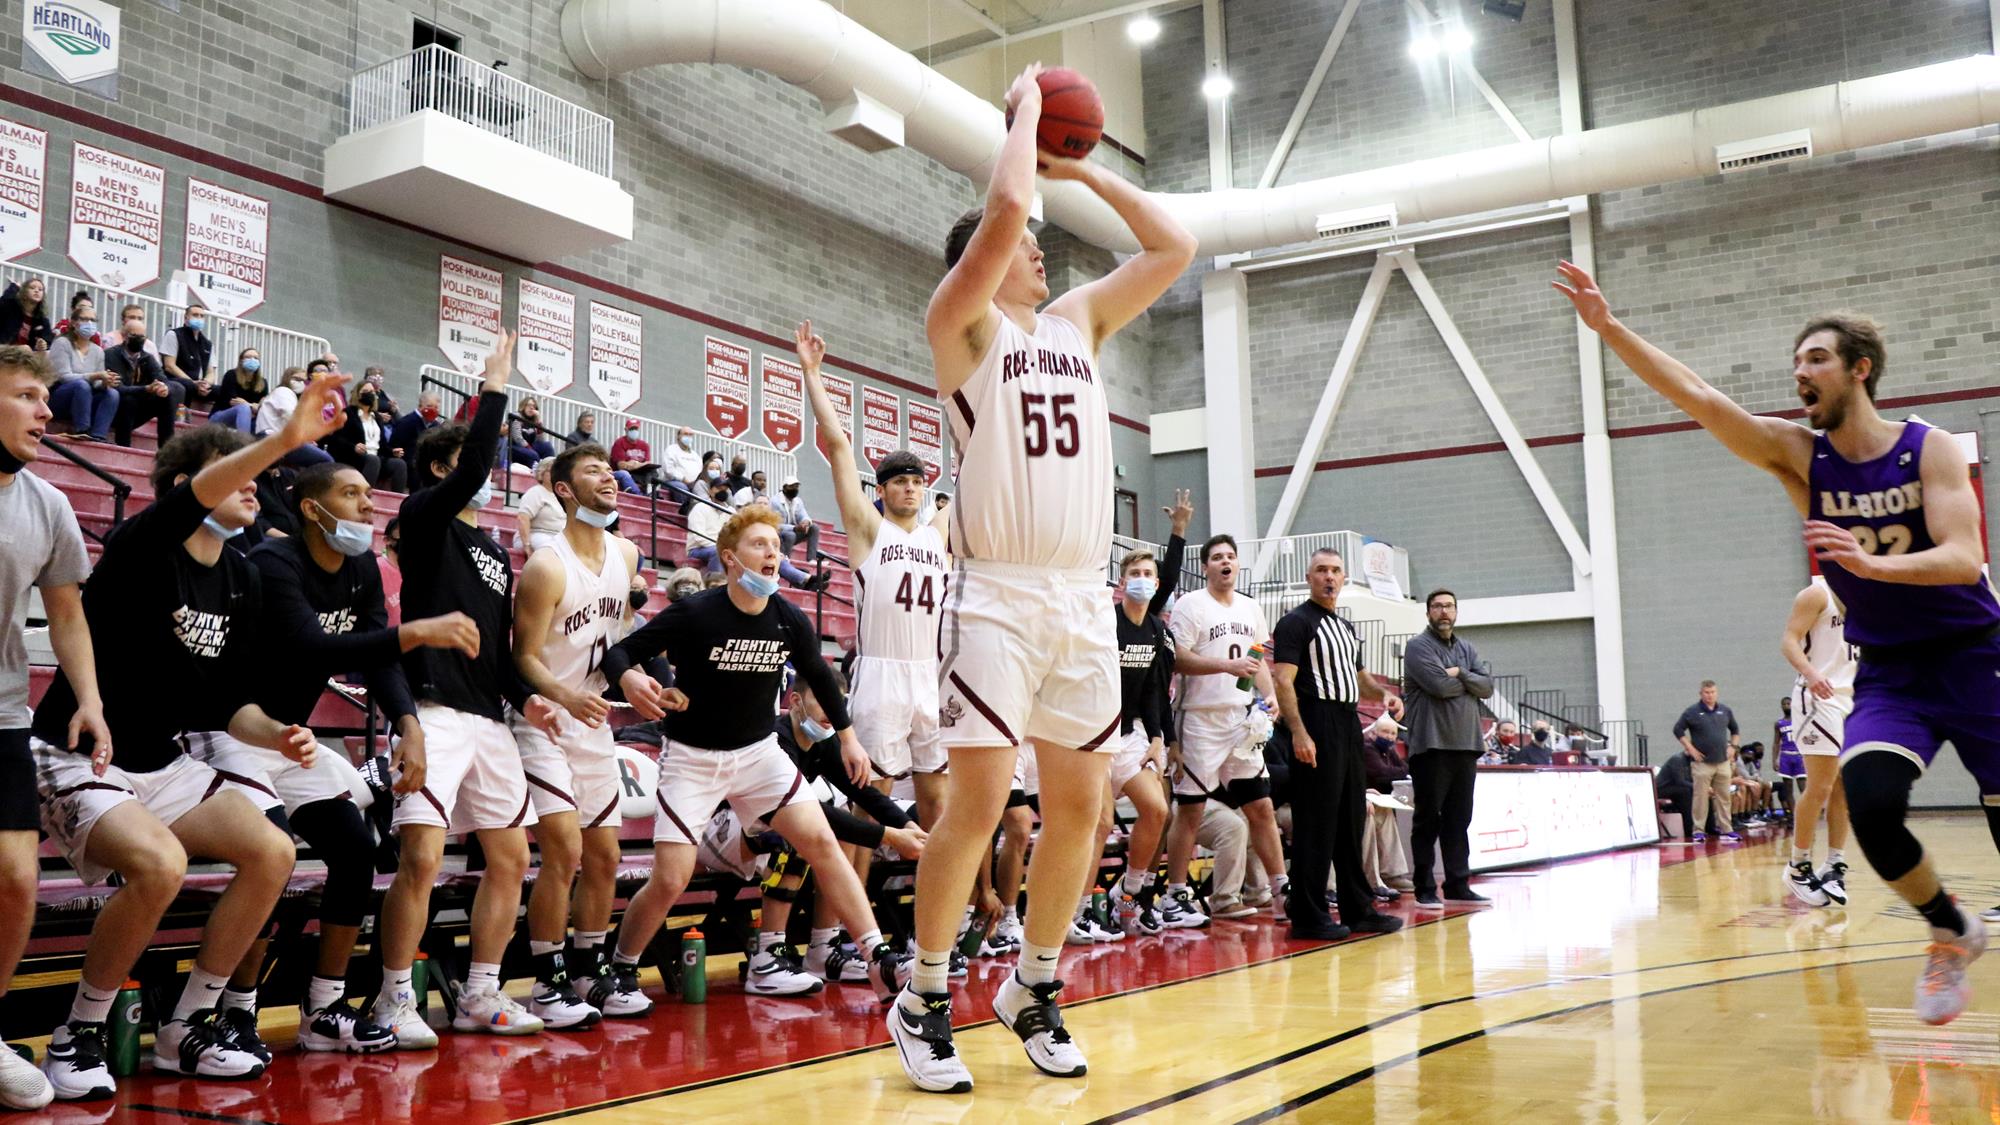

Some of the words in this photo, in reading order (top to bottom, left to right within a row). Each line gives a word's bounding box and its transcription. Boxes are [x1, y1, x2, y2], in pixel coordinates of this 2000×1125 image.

[33, 6, 111, 50] HEARTLAND
[78, 148, 161, 182] ROSE-HULMAN
[99, 175, 140, 196] MEN'S
[75, 181, 159, 215] BASKETBALL
[191, 185, 266, 216] ROSE-HULMAN
[75, 198, 159, 228] TOURNAMENT
[210, 213, 247, 234] MEN'S
[75, 207, 158, 242] CHAMPIONS
[88, 227, 147, 251] Heartland
[188, 222, 266, 255] BASKETBALL
[103, 252, 128, 265] 2014
[190, 243, 229, 260] REGULAR
[230, 252, 261, 269] SEASON
[189, 253, 262, 283] CHAMPIONS
[443, 261, 500, 284] ROSE-HULMAN
[199, 273, 252, 295] Heartland
[442, 278, 501, 305] VOLLEYBALL
[521, 283, 573, 305] ROSE-HULMAN
[447, 297, 494, 318] TOURNAMENT
[521, 302, 572, 325] VOLLEYBALL
[592, 306, 640, 327] ROSE-HULMAN
[442, 307, 498, 332] CHAMPIONS
[521, 325, 572, 348] CHAMPIONS
[592, 323, 640, 345] VOLLEYBALL
[592, 348, 639, 370] CHAMPIONS
[708, 341, 748, 360] ROSE-HULMAN
[708, 364, 748, 384] BASKETBALL
[713, 357, 743, 374] WOMEN'S
[708, 383, 748, 402] CHAMPIONS
[764, 381, 802, 398] BASKETBALL
[768, 374, 797, 390] WOMEN'S
[764, 399, 801, 417] CHAMPIONS
[867, 405, 894, 422] WOMEN'S
[864, 415, 898, 433] BASKETBALL
[912, 419, 937, 434] WOMEN'S
[1021, 391, 1080, 458] 55
[895, 571, 935, 615] 44
[708, 646, 791, 664] ENGINEERS
[725, 638, 784, 652] FIGHTIN'
[717, 662, 779, 673] BASKETBALL
